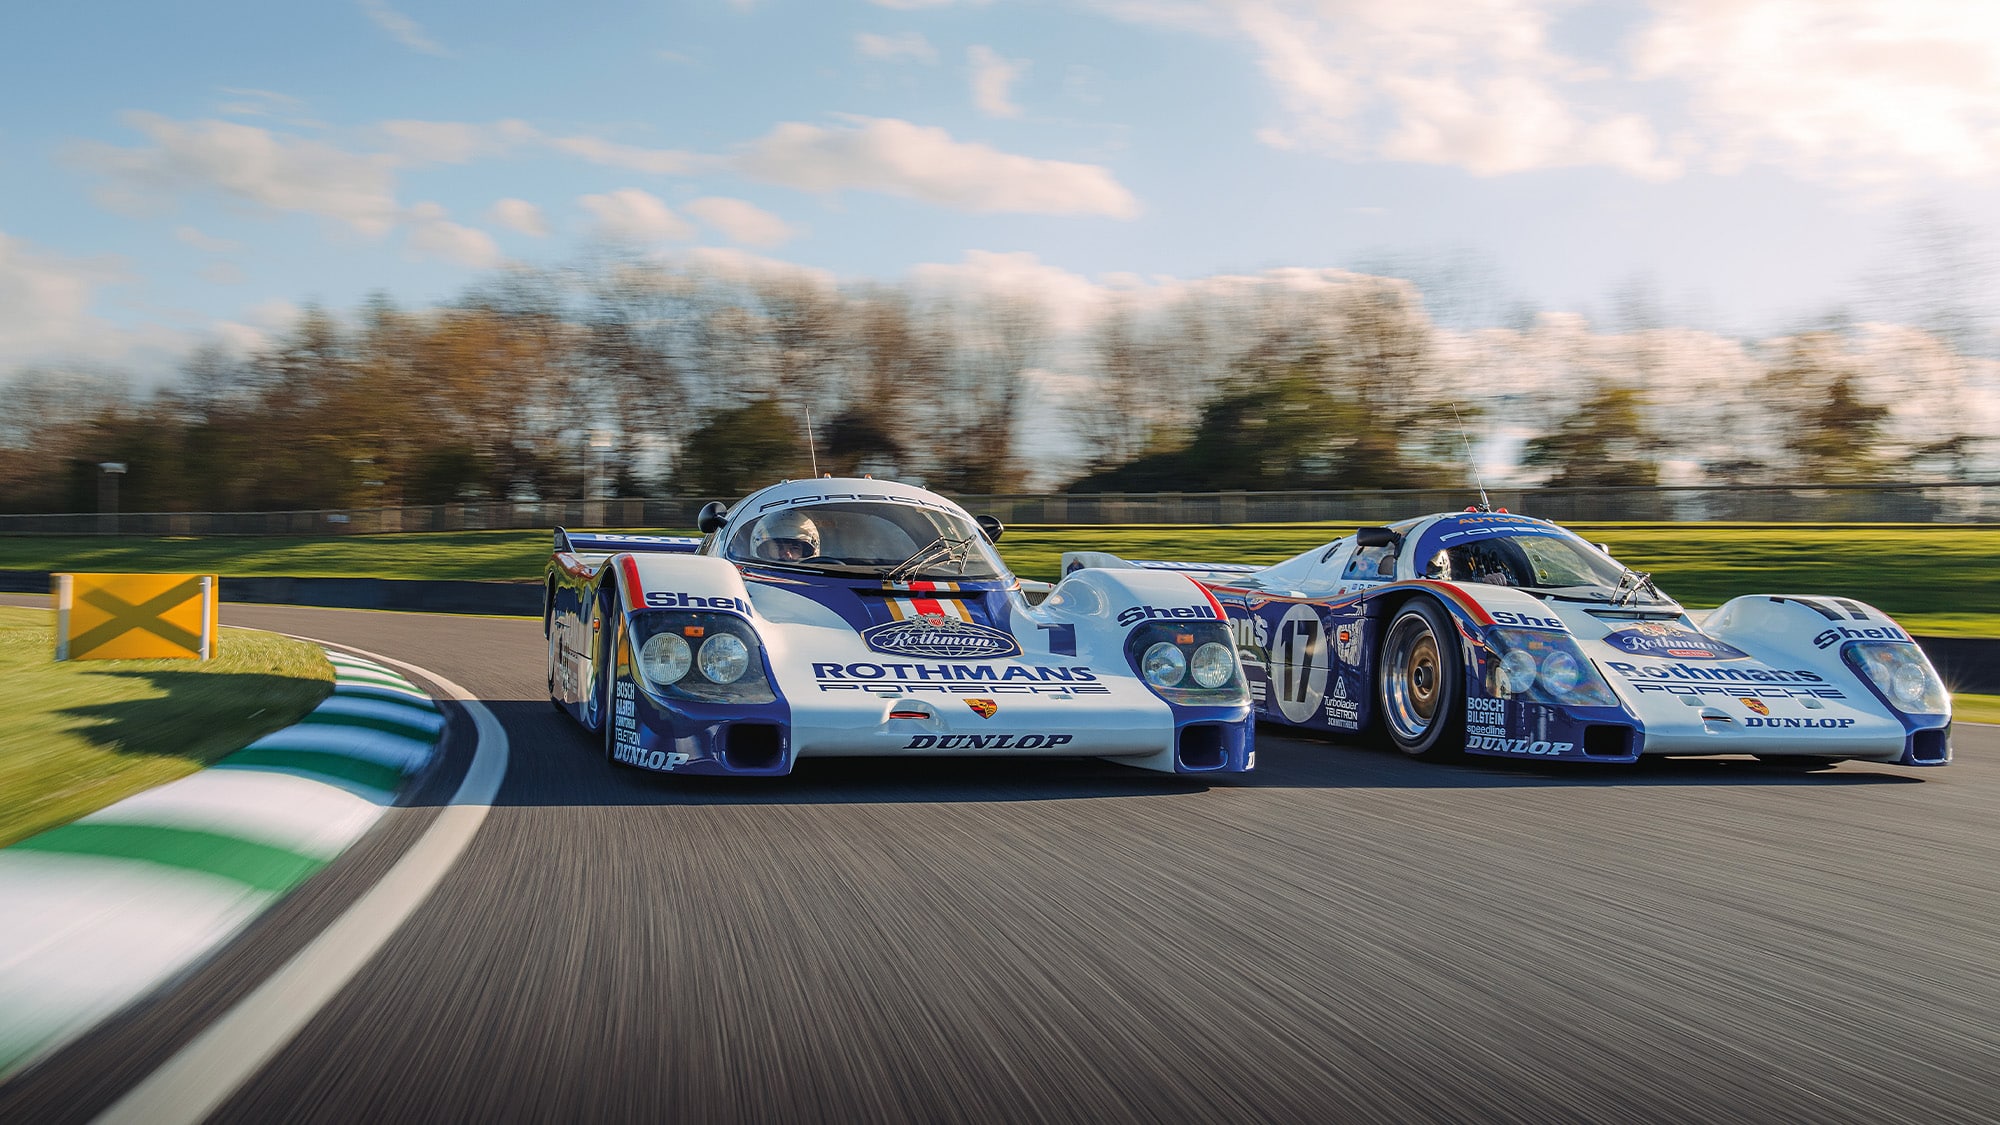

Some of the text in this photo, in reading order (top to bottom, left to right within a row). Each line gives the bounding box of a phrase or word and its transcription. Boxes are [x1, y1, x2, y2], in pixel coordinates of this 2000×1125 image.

[645, 591, 753, 618] Shell
[1117, 605, 1216, 627] Shell
[882, 629, 999, 648] Rothmans
[1036, 623, 1077, 657] 1
[1622, 636, 1731, 652] Rothmans
[1813, 626, 1904, 650] Shell
[1281, 619, 1318, 703] 17
[811, 662, 1097, 682] ROTHMANS
[1604, 661, 1823, 683] Rothmans
[616, 681, 635, 700] BOSCH
[818, 684, 1112, 695] PORSCHE
[1632, 683, 1848, 699] PORSCHE
[1325, 706, 1358, 721] TELETRON
[1467, 697, 1505, 712] BOSCH
[1467, 711, 1505, 725] BILSTEIN
[1744, 717, 1856, 729] DUNLOP
[1466, 725, 1507, 736] speedline
[902, 734, 1073, 750] DUNLOP
[1466, 735, 1574, 756] DUNLOP
[614, 742, 690, 771] DUNLOP
